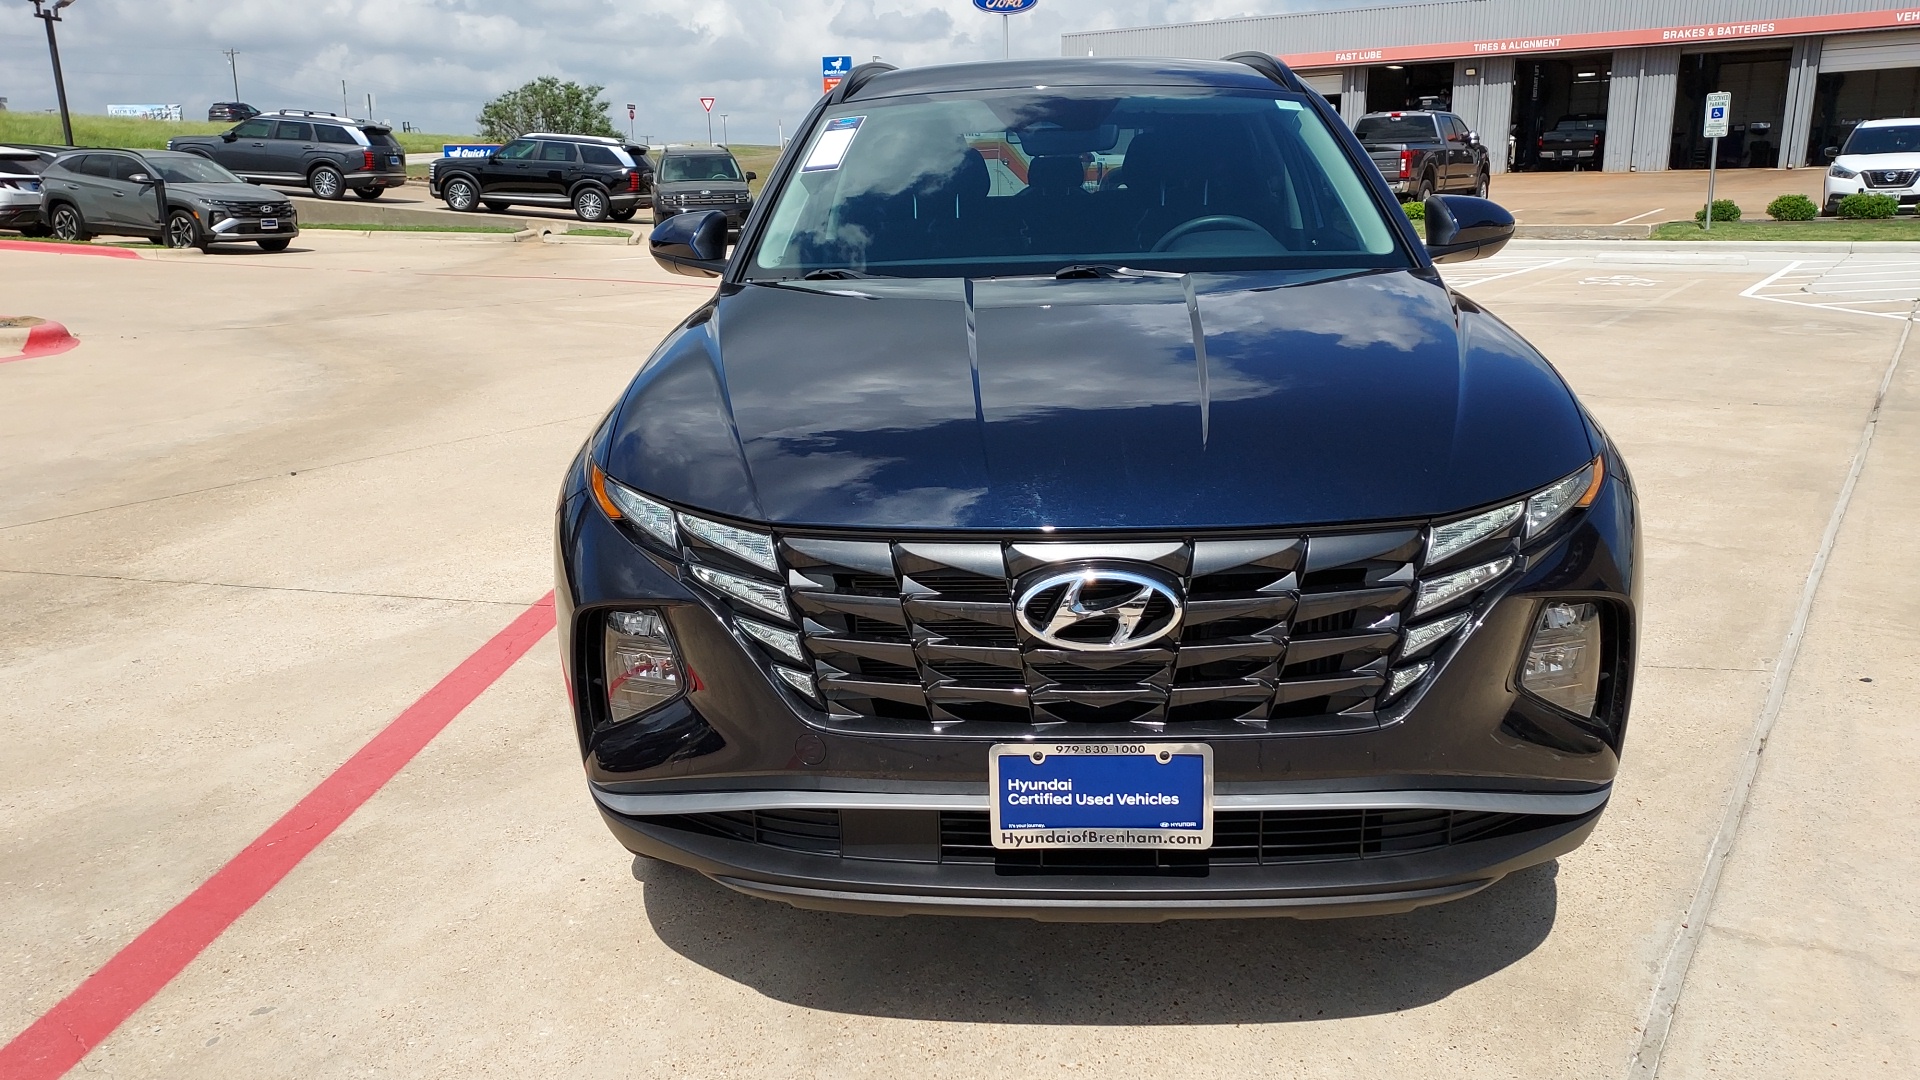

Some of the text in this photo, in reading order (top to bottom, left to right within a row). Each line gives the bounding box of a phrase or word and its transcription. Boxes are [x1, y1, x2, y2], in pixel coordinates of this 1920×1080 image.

[1663, 23, 1775, 40] BRAKES & BATTERIES
[1474, 38, 1561, 52] TIRES & ALIGNMENT
[1335, 50, 1382, 62] FAST LUBE
[462, 149, 485, 157] Quick
[1055, 745, 1146, 754] 979-830-1000
[1008, 778, 1072, 793] Hyundai
[1008, 793, 1179, 806] Certified Used Vehicles
[1001, 830, 1202, 847] HyundaiofBrenham.com
